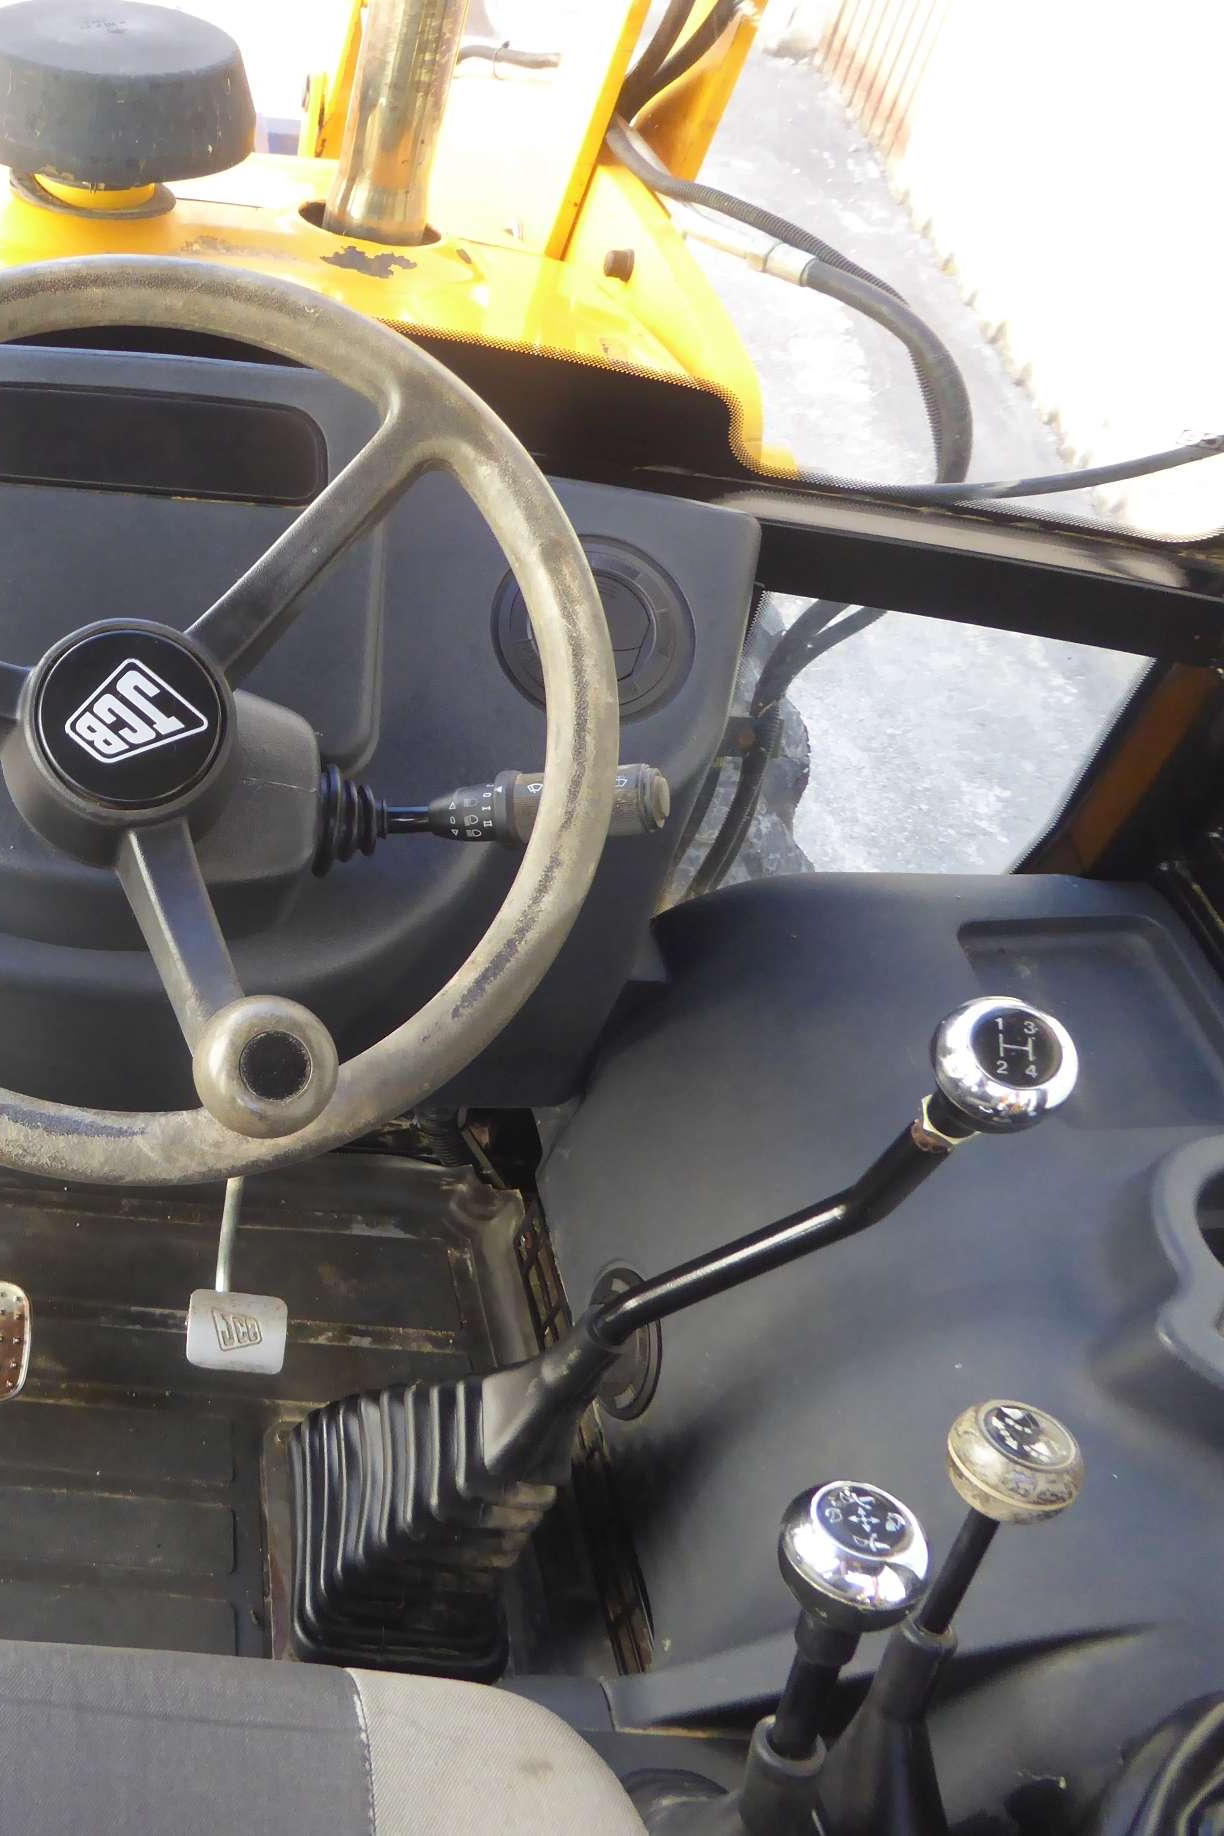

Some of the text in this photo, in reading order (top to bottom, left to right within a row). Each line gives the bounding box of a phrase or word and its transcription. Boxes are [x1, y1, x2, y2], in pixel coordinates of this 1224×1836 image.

[75, 670, 185, 755] JCB
[994, 1018, 1005, 1031] 1
[1024, 1021, 1037, 1034] 3
[996, 1060, 1009, 1075] 2
[1025, 1065, 1038, 1079] 4
[220, 1311, 259, 1347] JCB
